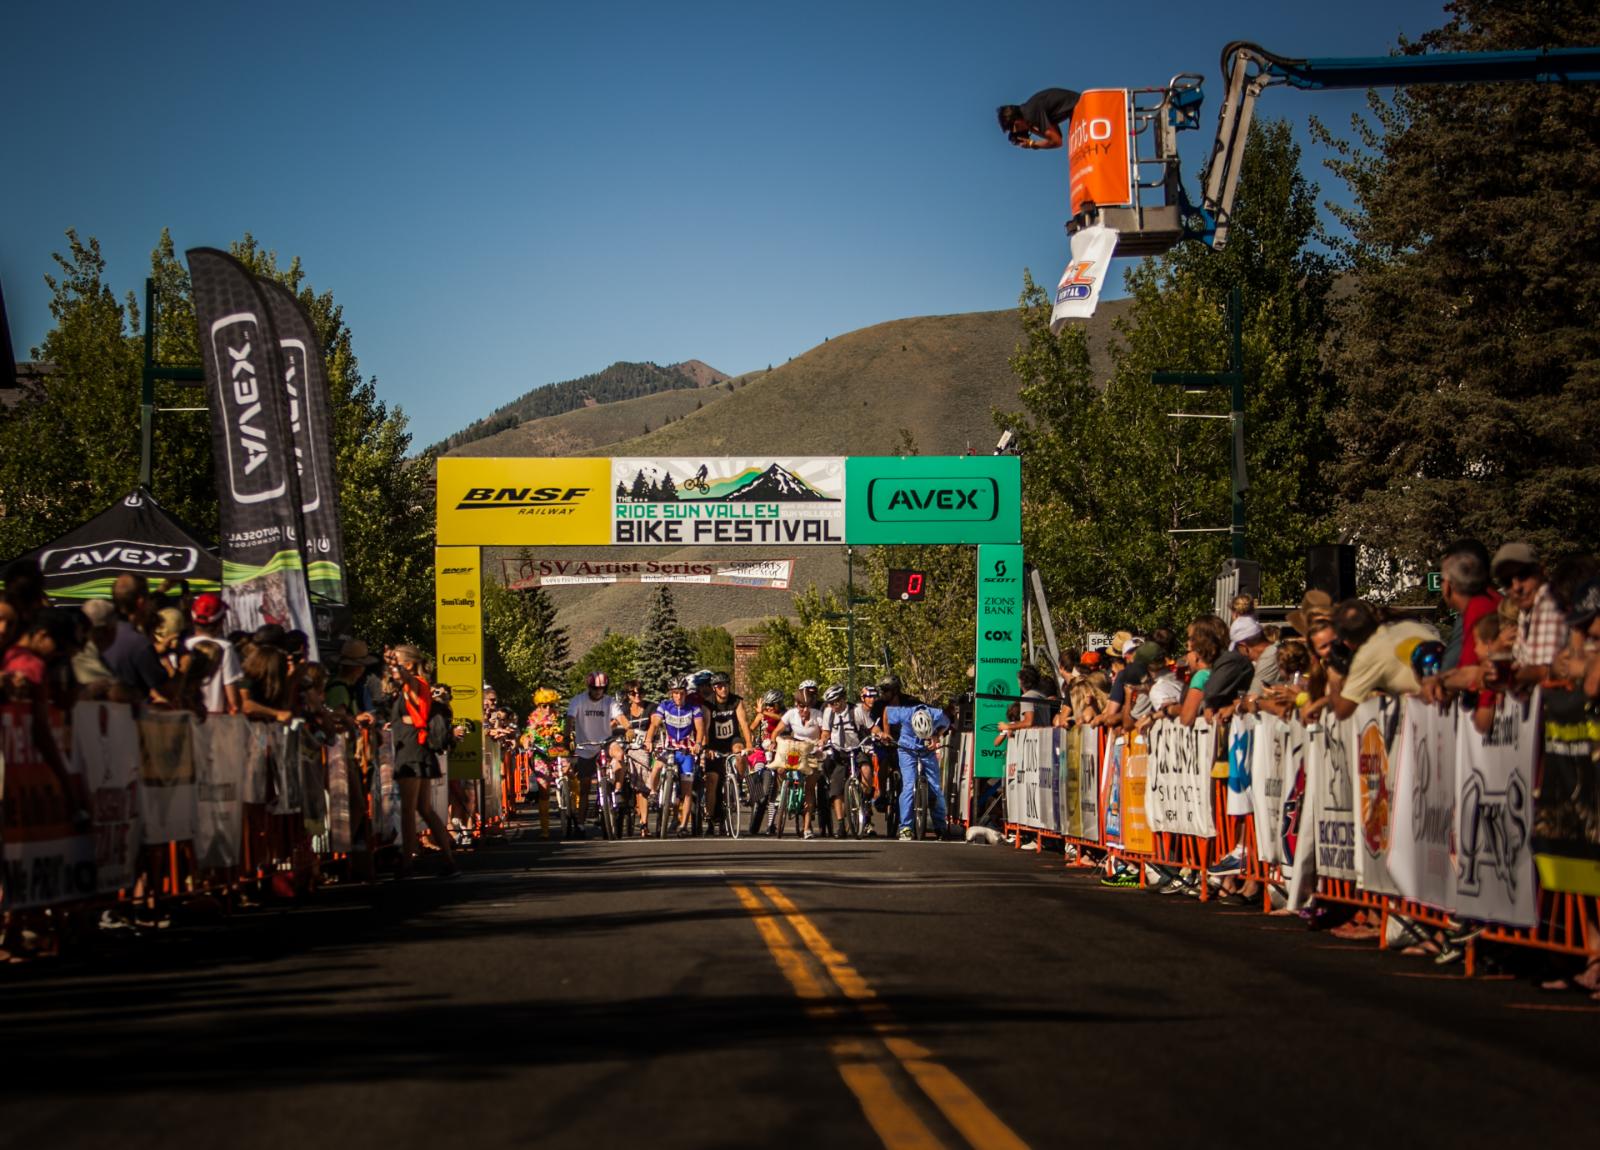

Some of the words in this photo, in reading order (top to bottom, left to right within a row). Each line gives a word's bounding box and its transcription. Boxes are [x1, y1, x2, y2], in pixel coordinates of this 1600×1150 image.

[462, 488, 590, 502] BNSF
[888, 490, 978, 510] AVEX
[616, 505, 658, 518] RIDE
[664, 505, 700, 518] SUN
[705, 505, 779, 518] VALLEY
[616, 520, 682, 542] BIKE
[694, 520, 842, 542] FESTIVAL
[60, 548, 172, 569] AVEX
[540, 560, 572, 576] SV
[574, 560, 640, 575] Artist
[646, 560, 712, 575] Series
[908, 574, 922, 594] 0
[984, 598, 1015, 606] ZIONS
[984, 606, 1014, 615] BANK
[984, 630, 1012, 641] COX
[717, 724, 732, 736] 101
